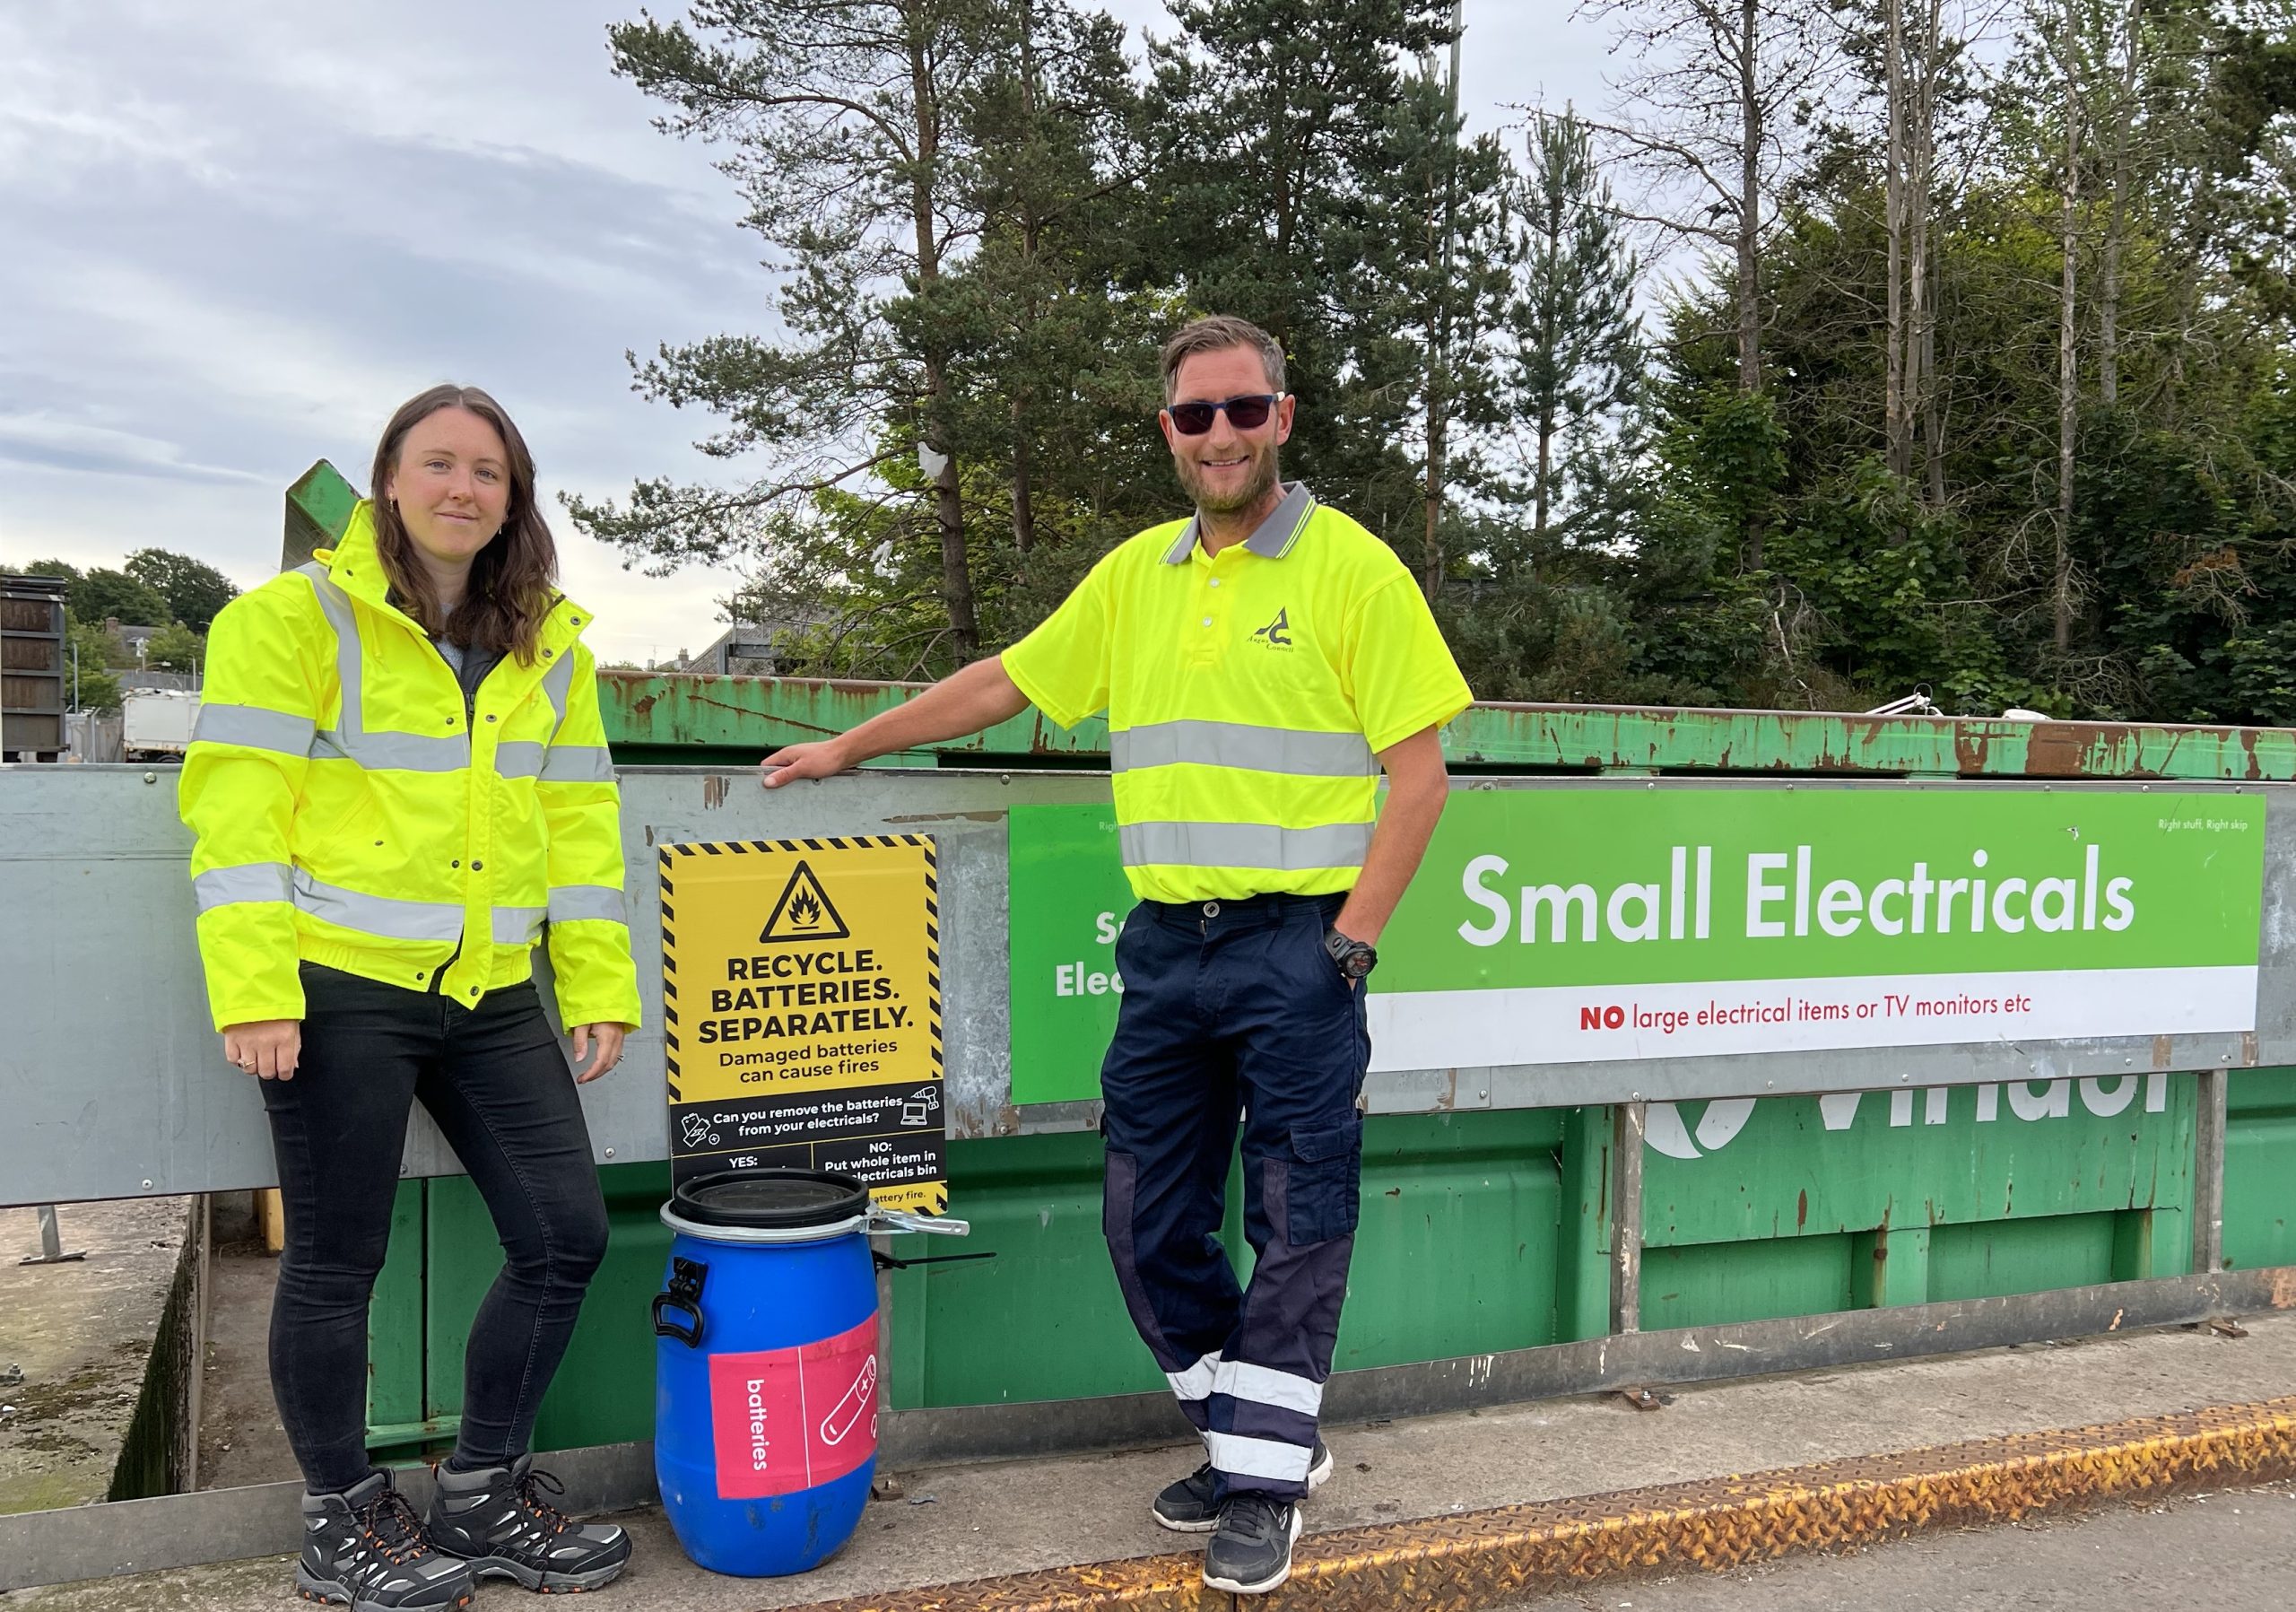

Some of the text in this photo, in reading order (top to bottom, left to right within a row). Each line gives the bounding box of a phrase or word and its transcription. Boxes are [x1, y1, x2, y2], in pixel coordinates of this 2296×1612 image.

[2159, 818, 2248, 832] Right stuff, Right skip
[1457, 844, 2135, 947] Small Electricals
[727, 949, 883, 981] RECYCLE.
[711, 978, 900, 1013] BATTERIES.
[698, 1006, 913, 1044] SEPARATELY.
[1580, 993, 2031, 1034] NO large electrical items or TV monitors etc
[719, 1039, 898, 1067] Damaged batteries
[739, 1059, 879, 1084] can cause fires
[713, 1095, 903, 1124] Can you remove the batteries
[738, 1112, 880, 1137] from your electricals?
[824, 1150, 936, 1172] Put whole item in
[869, 1142, 892, 1154] NO:
[728, 1155, 758, 1169] YES:
[917, 1164, 937, 1176] bin
[874, 1189, 926, 1204] attery fire.
[747, 1379, 770, 1471] batteries
